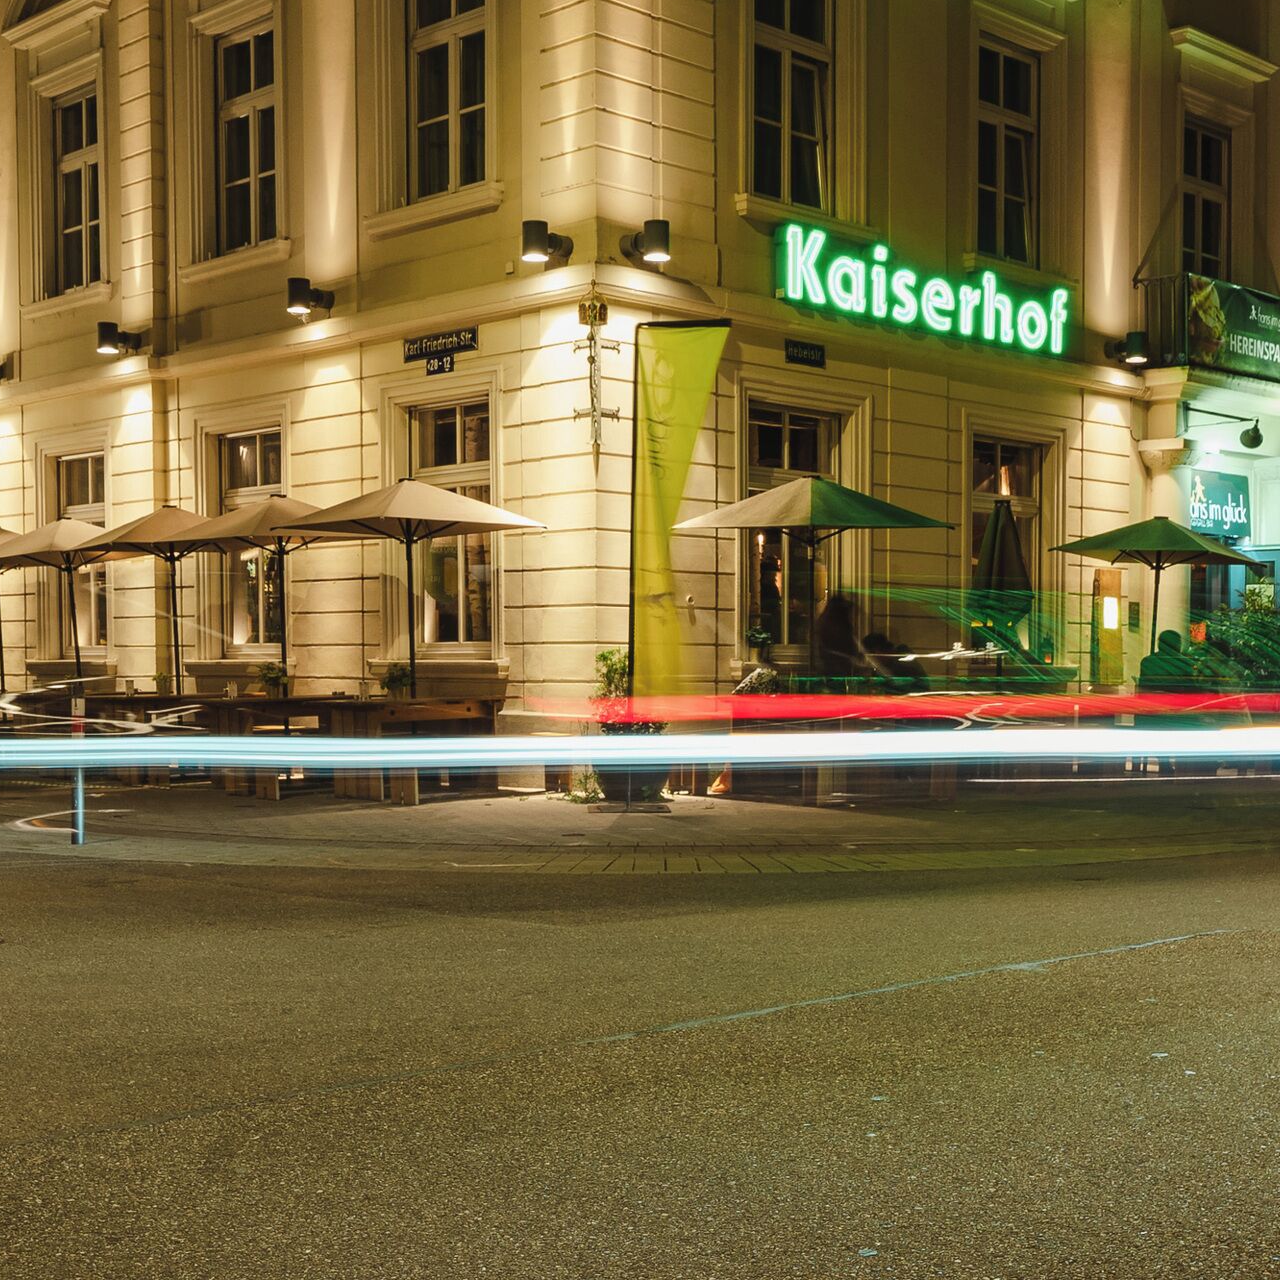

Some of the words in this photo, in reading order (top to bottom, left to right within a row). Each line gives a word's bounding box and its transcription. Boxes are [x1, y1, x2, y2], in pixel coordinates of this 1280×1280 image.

[786, 224, 1068, 353] Kaiserhof
[1209, 500, 1221, 521] im
[1222, 492, 1248, 530] glück
